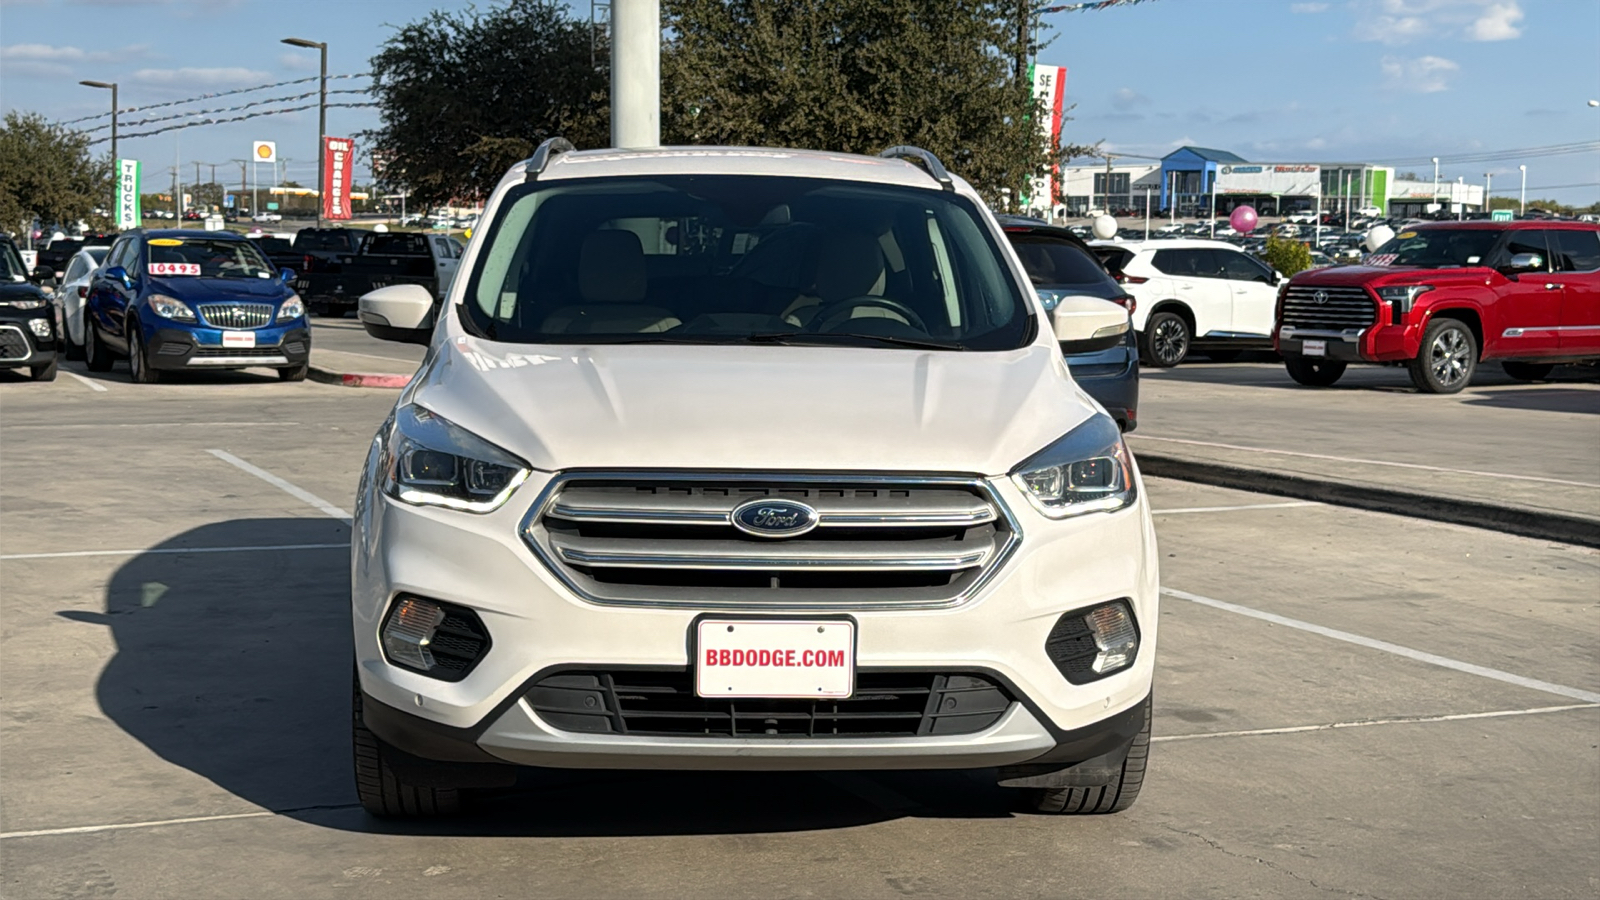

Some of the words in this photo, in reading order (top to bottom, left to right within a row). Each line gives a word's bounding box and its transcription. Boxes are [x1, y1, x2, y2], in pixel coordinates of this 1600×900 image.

[1039, 74, 1052, 87] SE
[328, 140, 349, 152] OIL
[123, 164, 133, 222] TRUCKS
[331, 152, 344, 215] CHANGES
[150, 263, 199, 274] 10495
[752, 507, 798, 527] Ford
[705, 649, 845, 668] BBDODGE.COM
